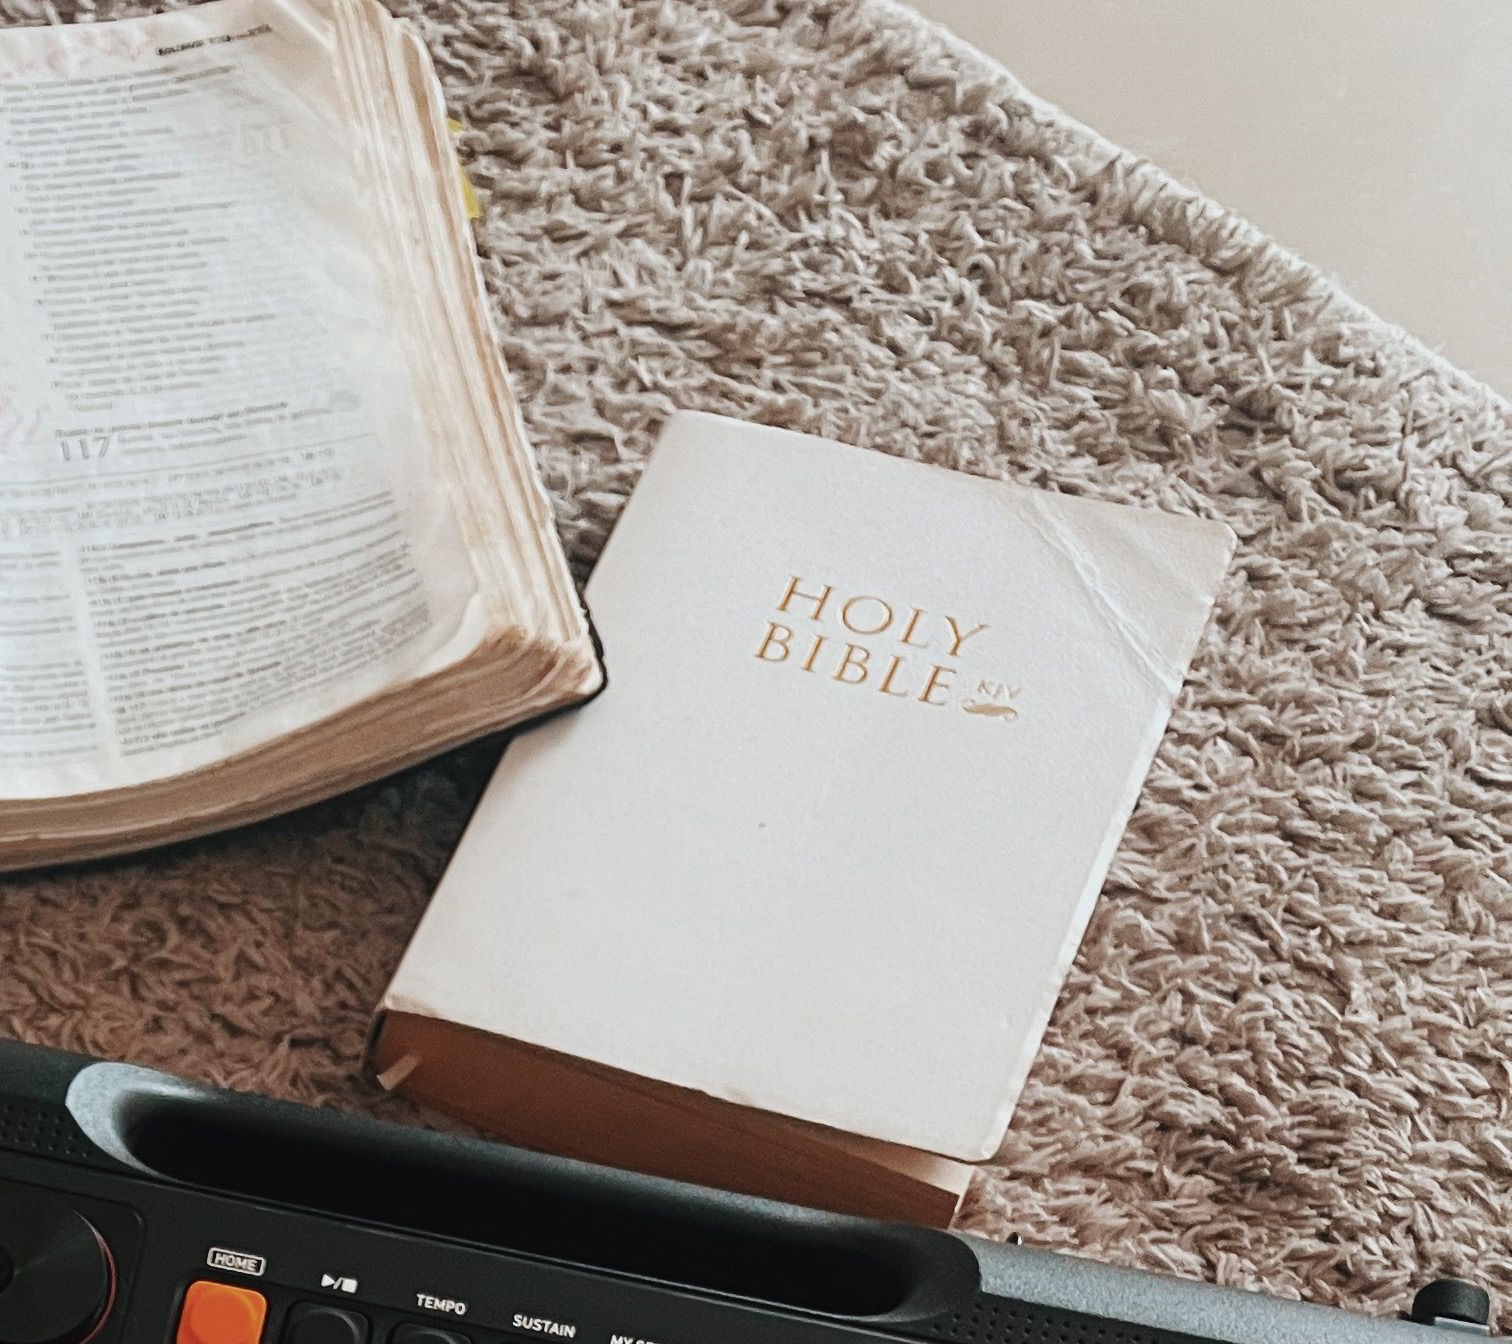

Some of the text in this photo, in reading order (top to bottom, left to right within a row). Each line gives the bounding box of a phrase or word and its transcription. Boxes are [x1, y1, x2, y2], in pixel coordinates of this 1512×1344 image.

[777, 575, 992, 657] HOLY
[753, 619, 958, 706] BIBLE
[214, 1252, 258, 1272] HOME
[416, 1293, 467, 1316] TEMPO
[512, 1314, 577, 1338] SUSTAIN
